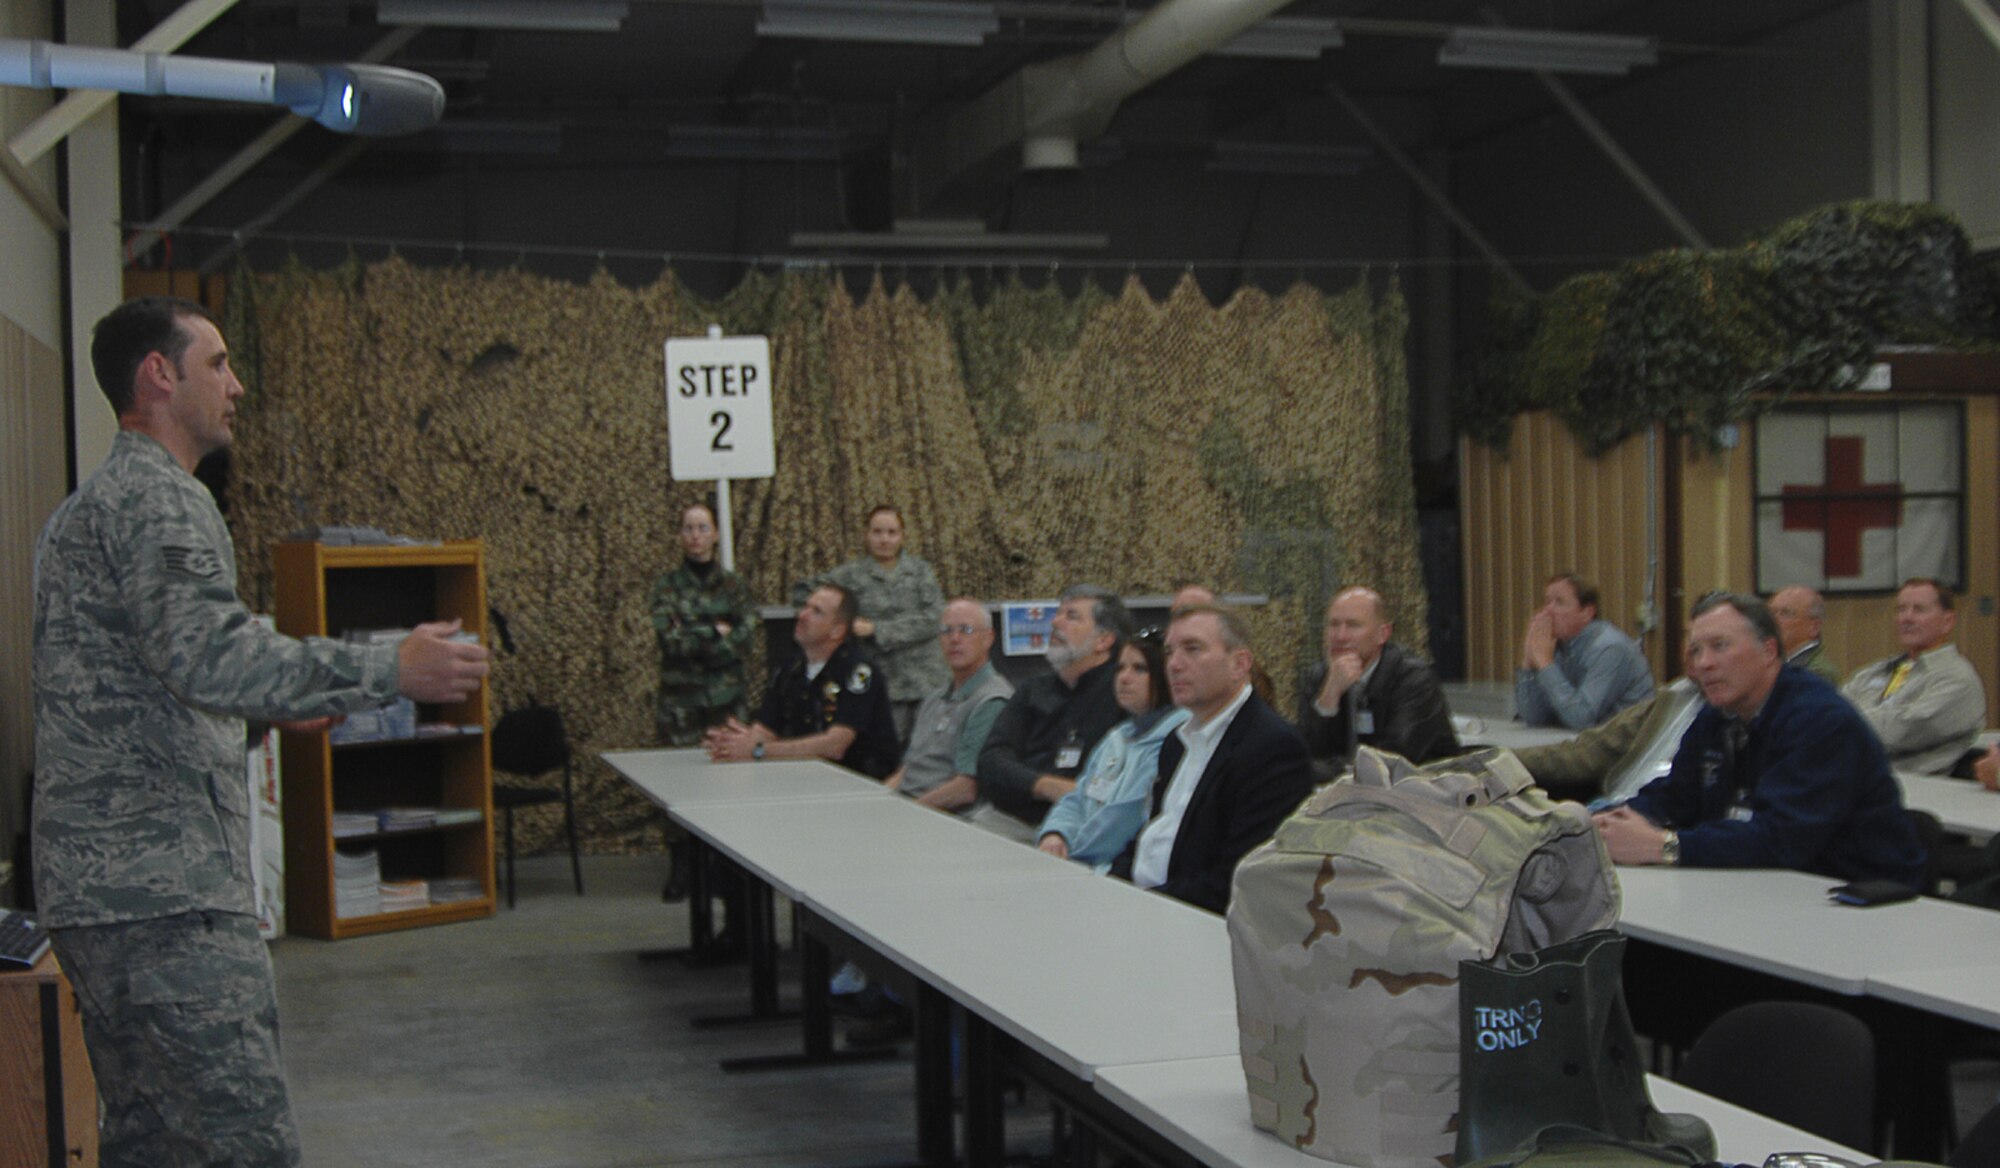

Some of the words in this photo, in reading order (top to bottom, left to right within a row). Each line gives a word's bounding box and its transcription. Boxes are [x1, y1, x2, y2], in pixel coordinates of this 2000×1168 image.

[679, 364, 757, 398] STEP
[710, 410, 734, 452] 2
[1477, 1018, 1543, 1052] ONLY
